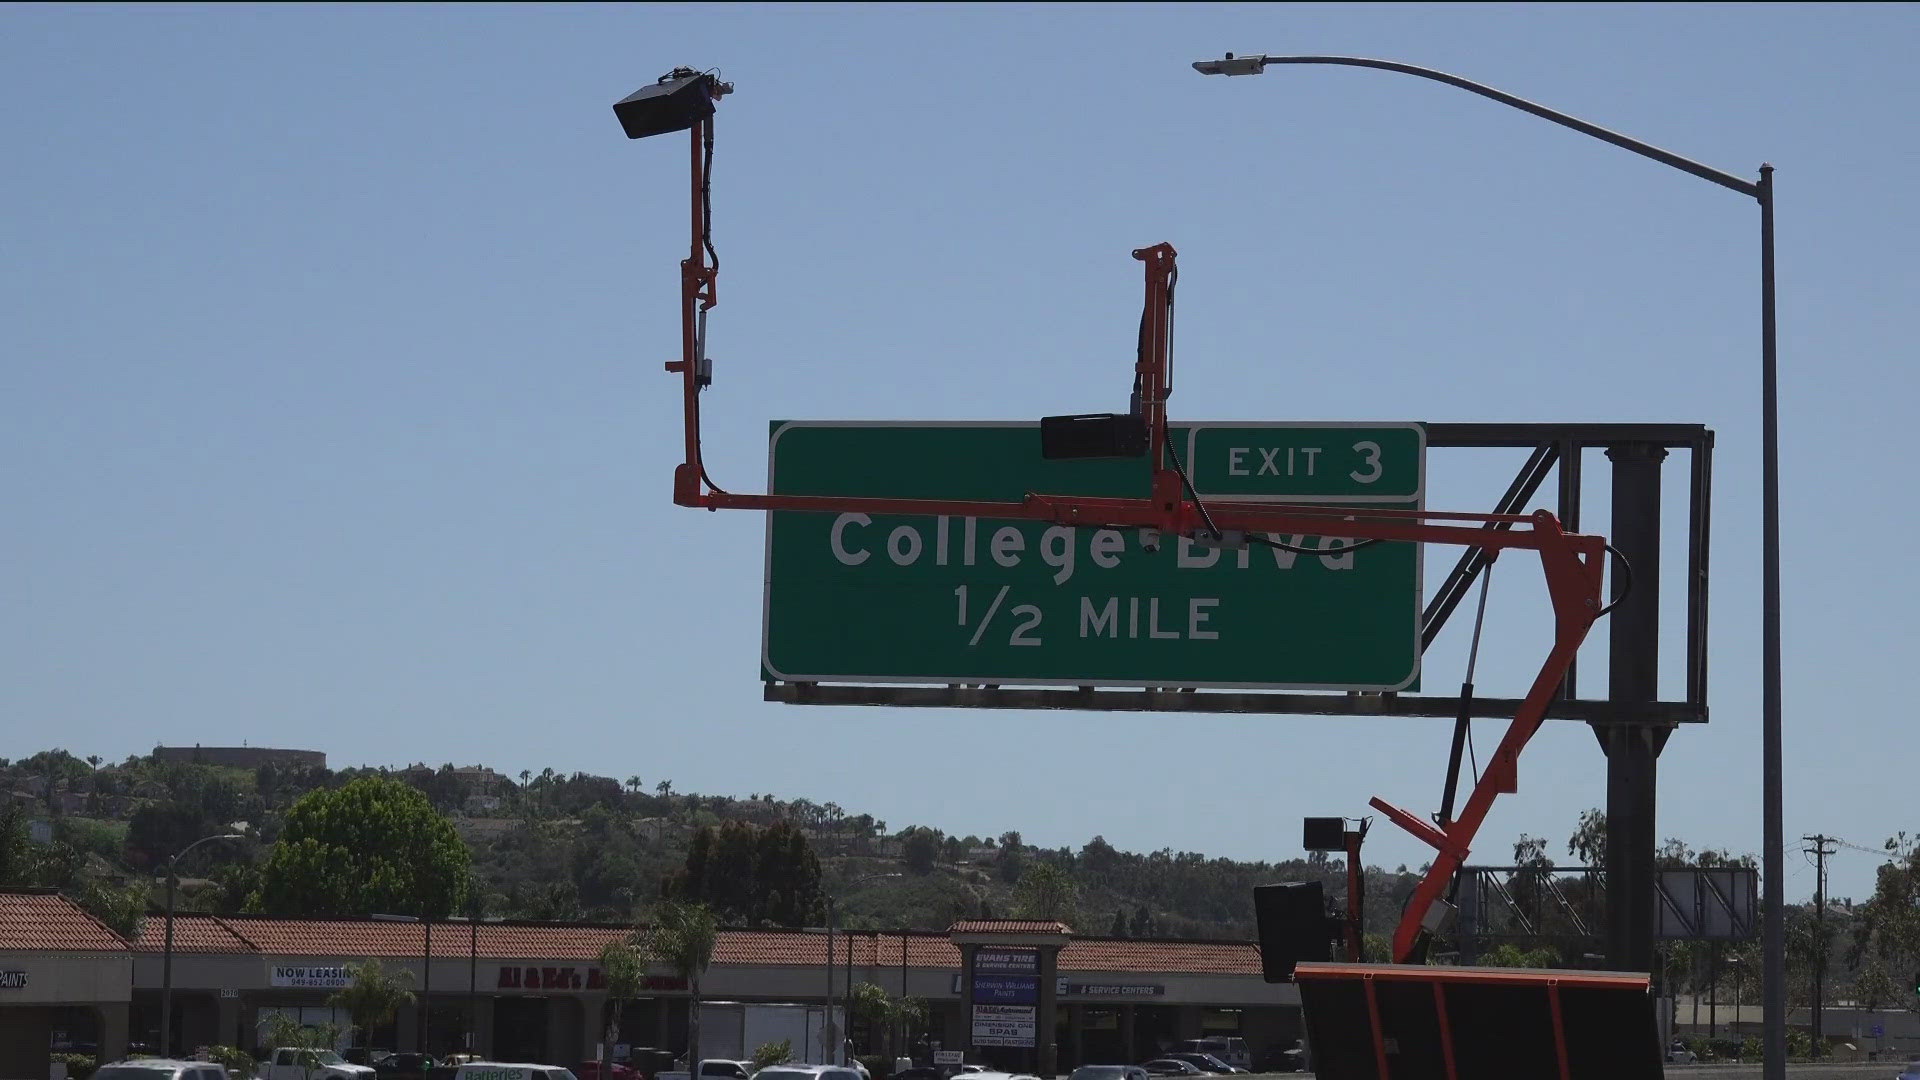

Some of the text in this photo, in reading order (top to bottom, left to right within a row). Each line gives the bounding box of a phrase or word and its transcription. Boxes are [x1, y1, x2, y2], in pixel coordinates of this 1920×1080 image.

[1229, 440, 1384, 484] EXIT 3
[830, 511, 1124, 586] College
[953, 584, 1220, 647] 1/2 MILE
[976, 953, 1036, 963] EVANS TIRE
[276, 967, 305, 978] NOW
[1005, 981, 1036, 990] WILLIAMS
[1088, 985, 1120, 994] SERVICE
[1121, 986, 1155, 995] CENTERS
[993, 989, 1015, 997] PAINTS
[989, 1028, 1018, 1036] SPAS
[465, 1068, 523, 1080] Batteries
